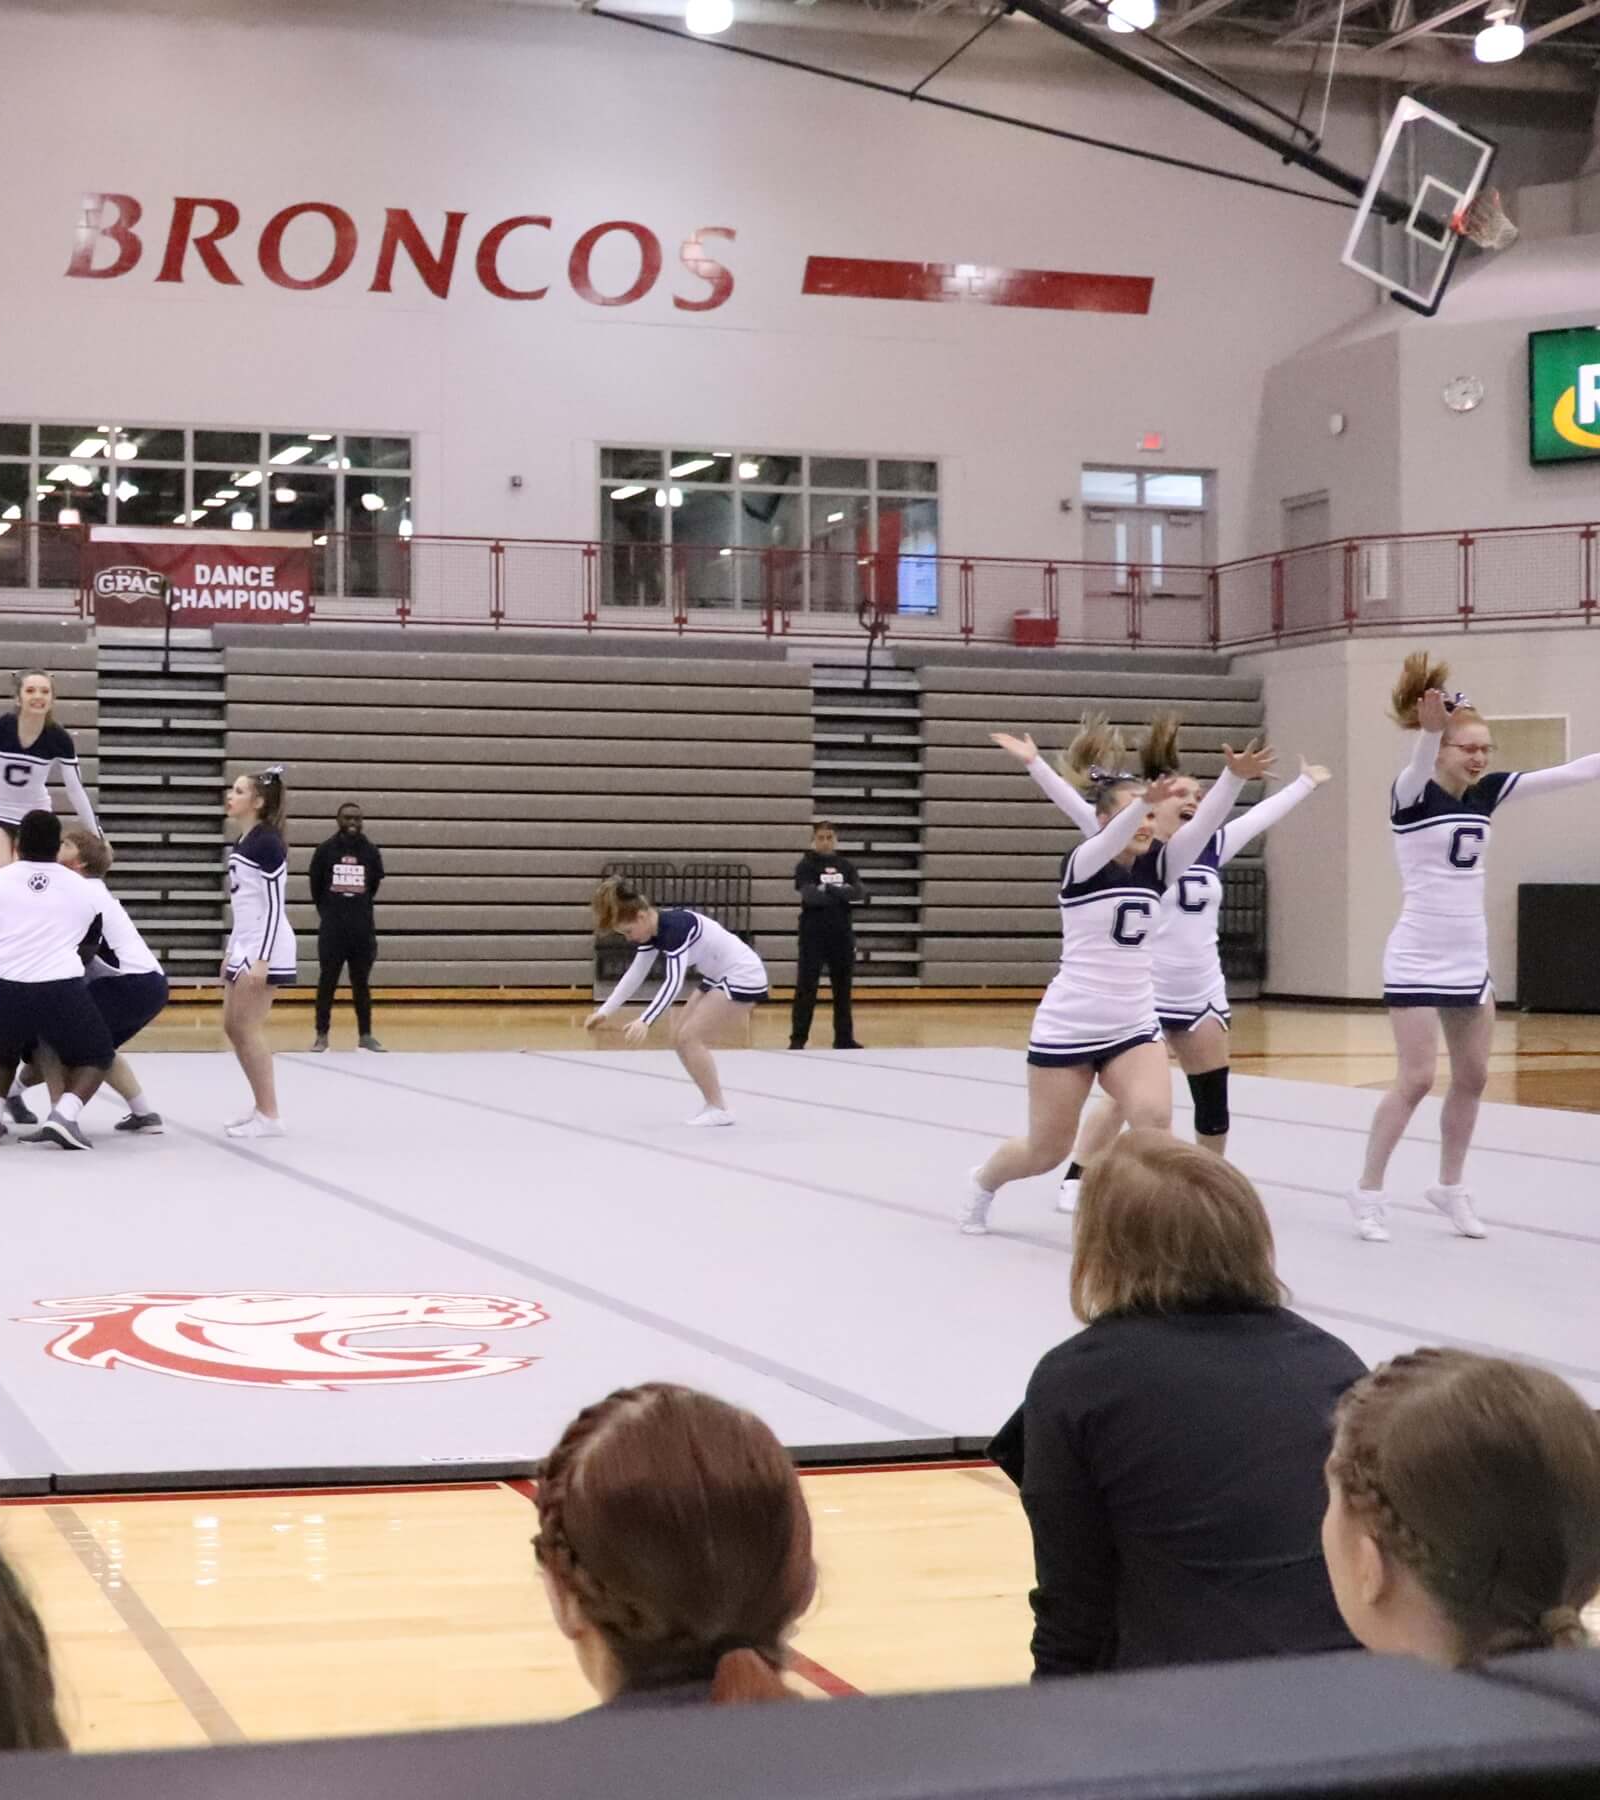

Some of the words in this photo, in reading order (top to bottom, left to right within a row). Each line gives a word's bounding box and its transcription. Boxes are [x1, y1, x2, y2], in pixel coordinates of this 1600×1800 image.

[65, 193, 737, 312] BRONCOS
[98, 574, 161, 595] GPAC
[195, 564, 275, 587] DANCE
[165, 588, 305, 614] CHAMPIONS
[3, 763, 33, 787] C
[1447, 824, 1486, 870] C
[1177, 874, 1209, 913] C
[1109, 900, 1152, 948] C
